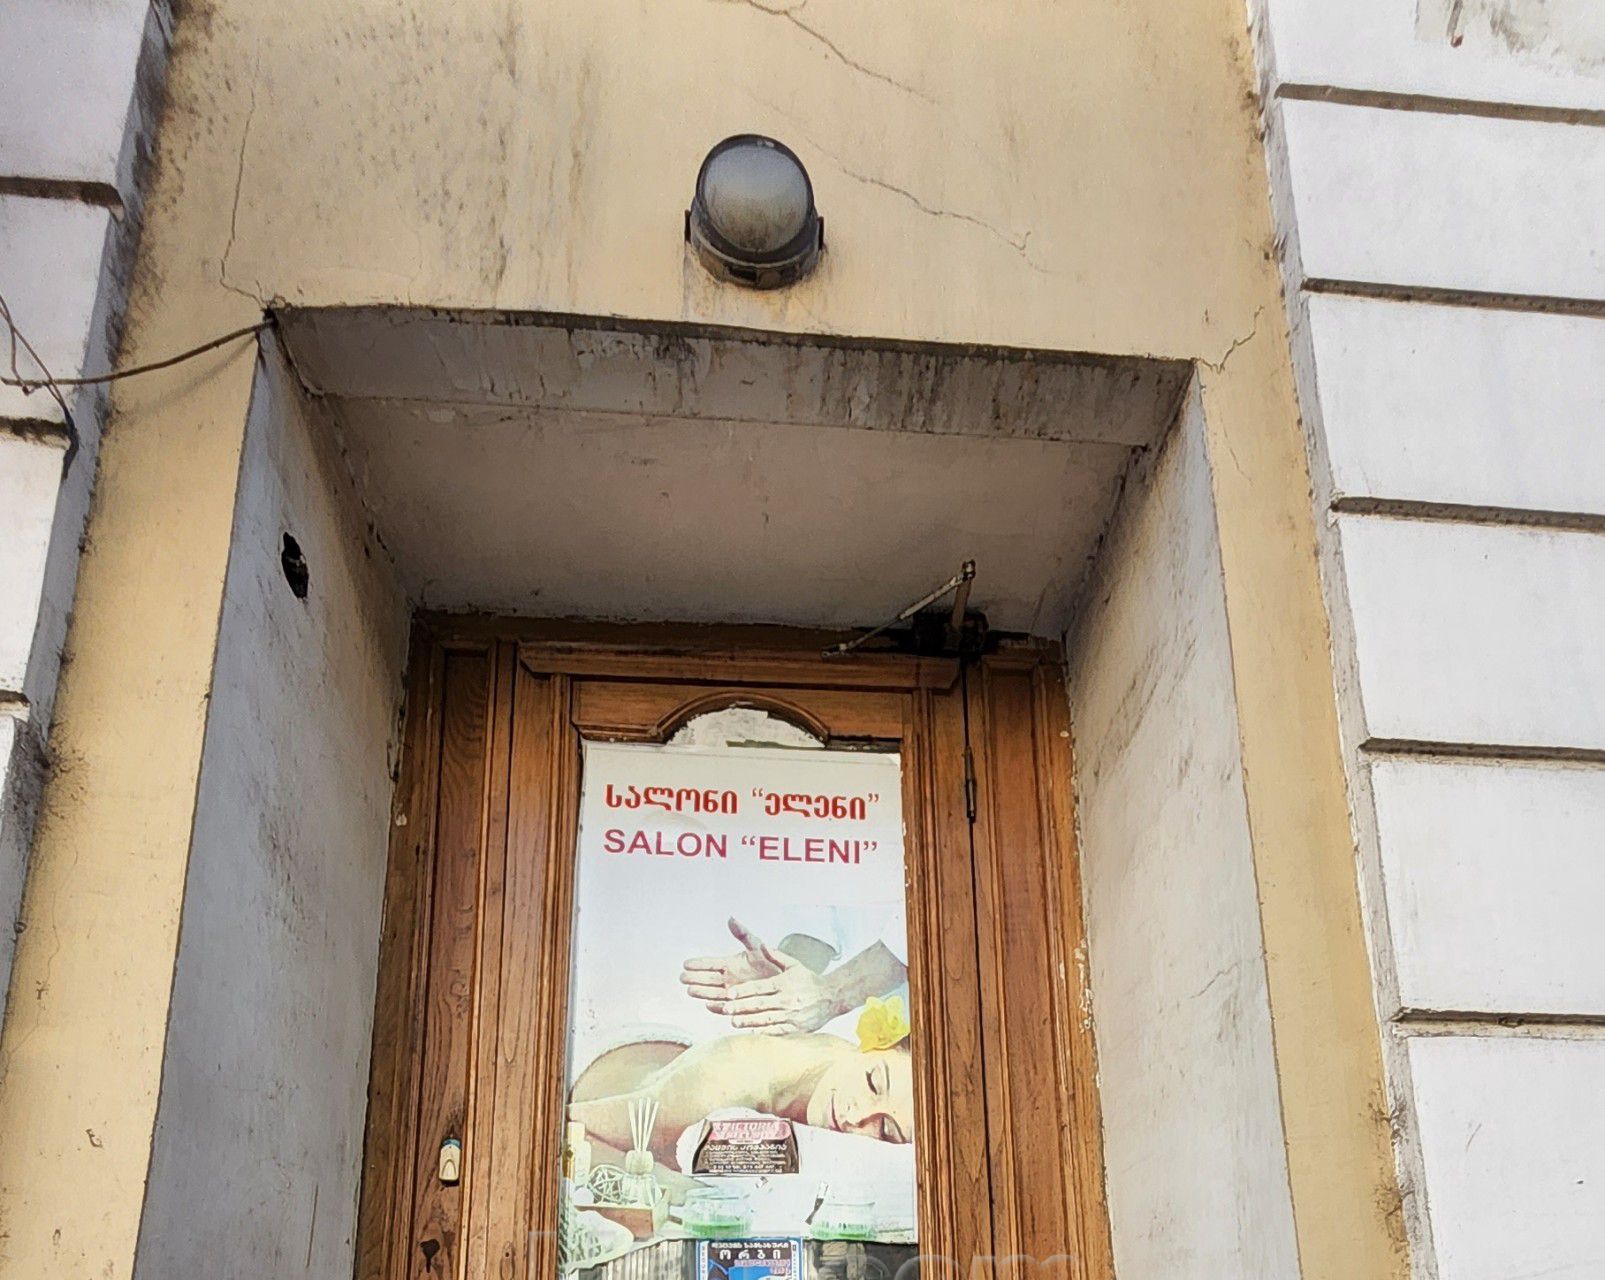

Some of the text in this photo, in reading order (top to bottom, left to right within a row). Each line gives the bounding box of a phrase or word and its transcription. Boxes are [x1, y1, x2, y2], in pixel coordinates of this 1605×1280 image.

[604, 783, 738, 815] სალონი
[603, 828, 879, 864] SALON “ELENI”
